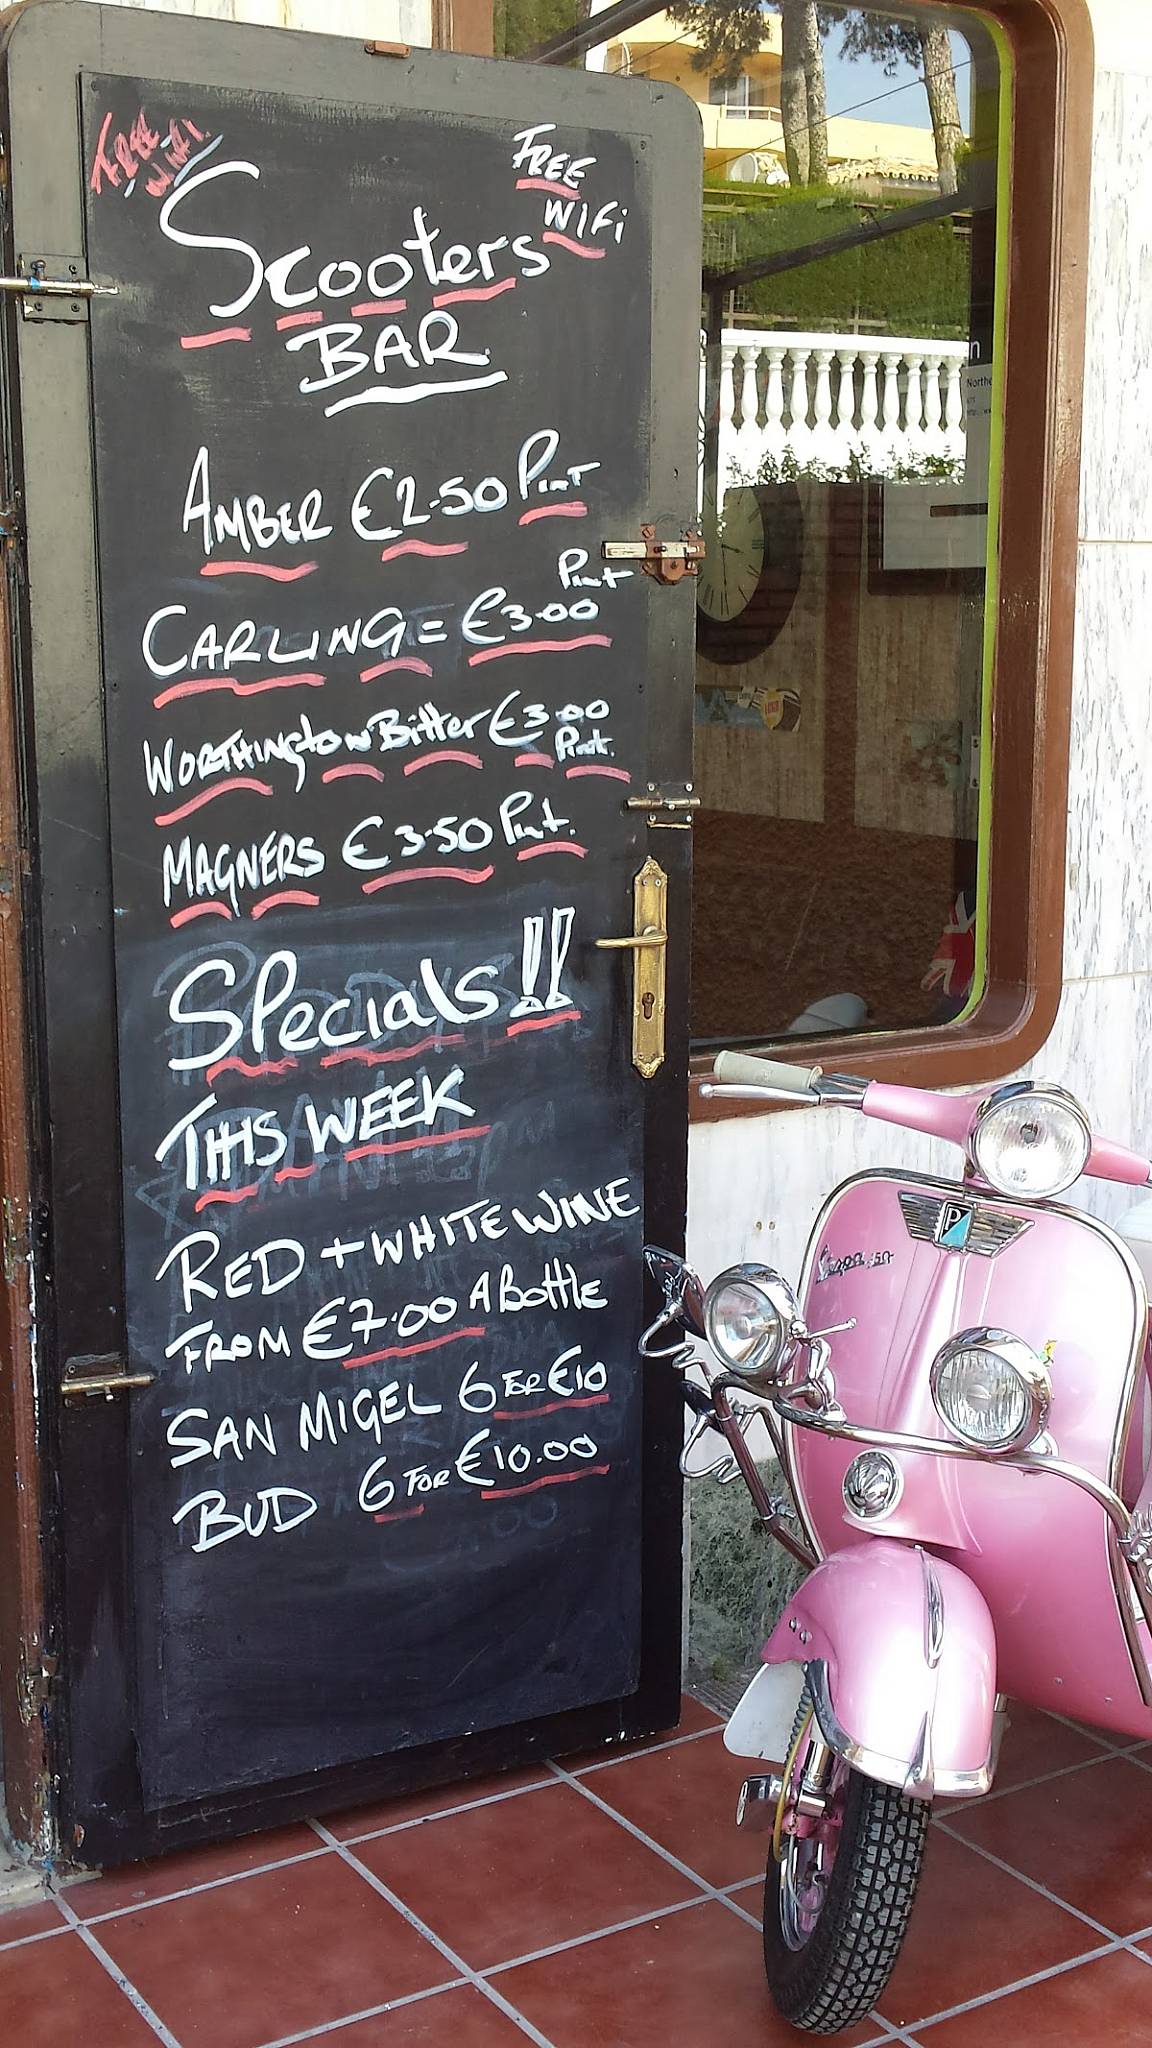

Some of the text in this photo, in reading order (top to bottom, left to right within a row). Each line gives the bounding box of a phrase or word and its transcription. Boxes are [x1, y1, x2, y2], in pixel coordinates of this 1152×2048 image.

[512, 123, 597, 190] FREE
[158, 160, 551, 318] Scooters
[285, 310, 491, 394] BAR
[182, 446, 333, 555] AMBER
[142, 604, 404, 678] CARLING
[366, 702, 492, 752] Bitter
[162, 831, 326, 916] MAGNERS
[154, 1093, 289, 1191] THIS
[305, 1069, 476, 1163] WEEK
[155, 1178, 641, 1313] RED + WHITE WINE
[165, 1321, 291, 1374] FROM
[468, 1271, 491, 1313] A
[166, 1408, 278, 1469] SAN
[299, 1382, 442, 1452] MIGEL
[458, 1361, 498, 1414] 6
[547, 1344, 607, 1397] €10
[171, 1487, 318, 1553] BUD
[358, 1456, 395, 1512] 6
[455, 1428, 599, 1487] €10.00
